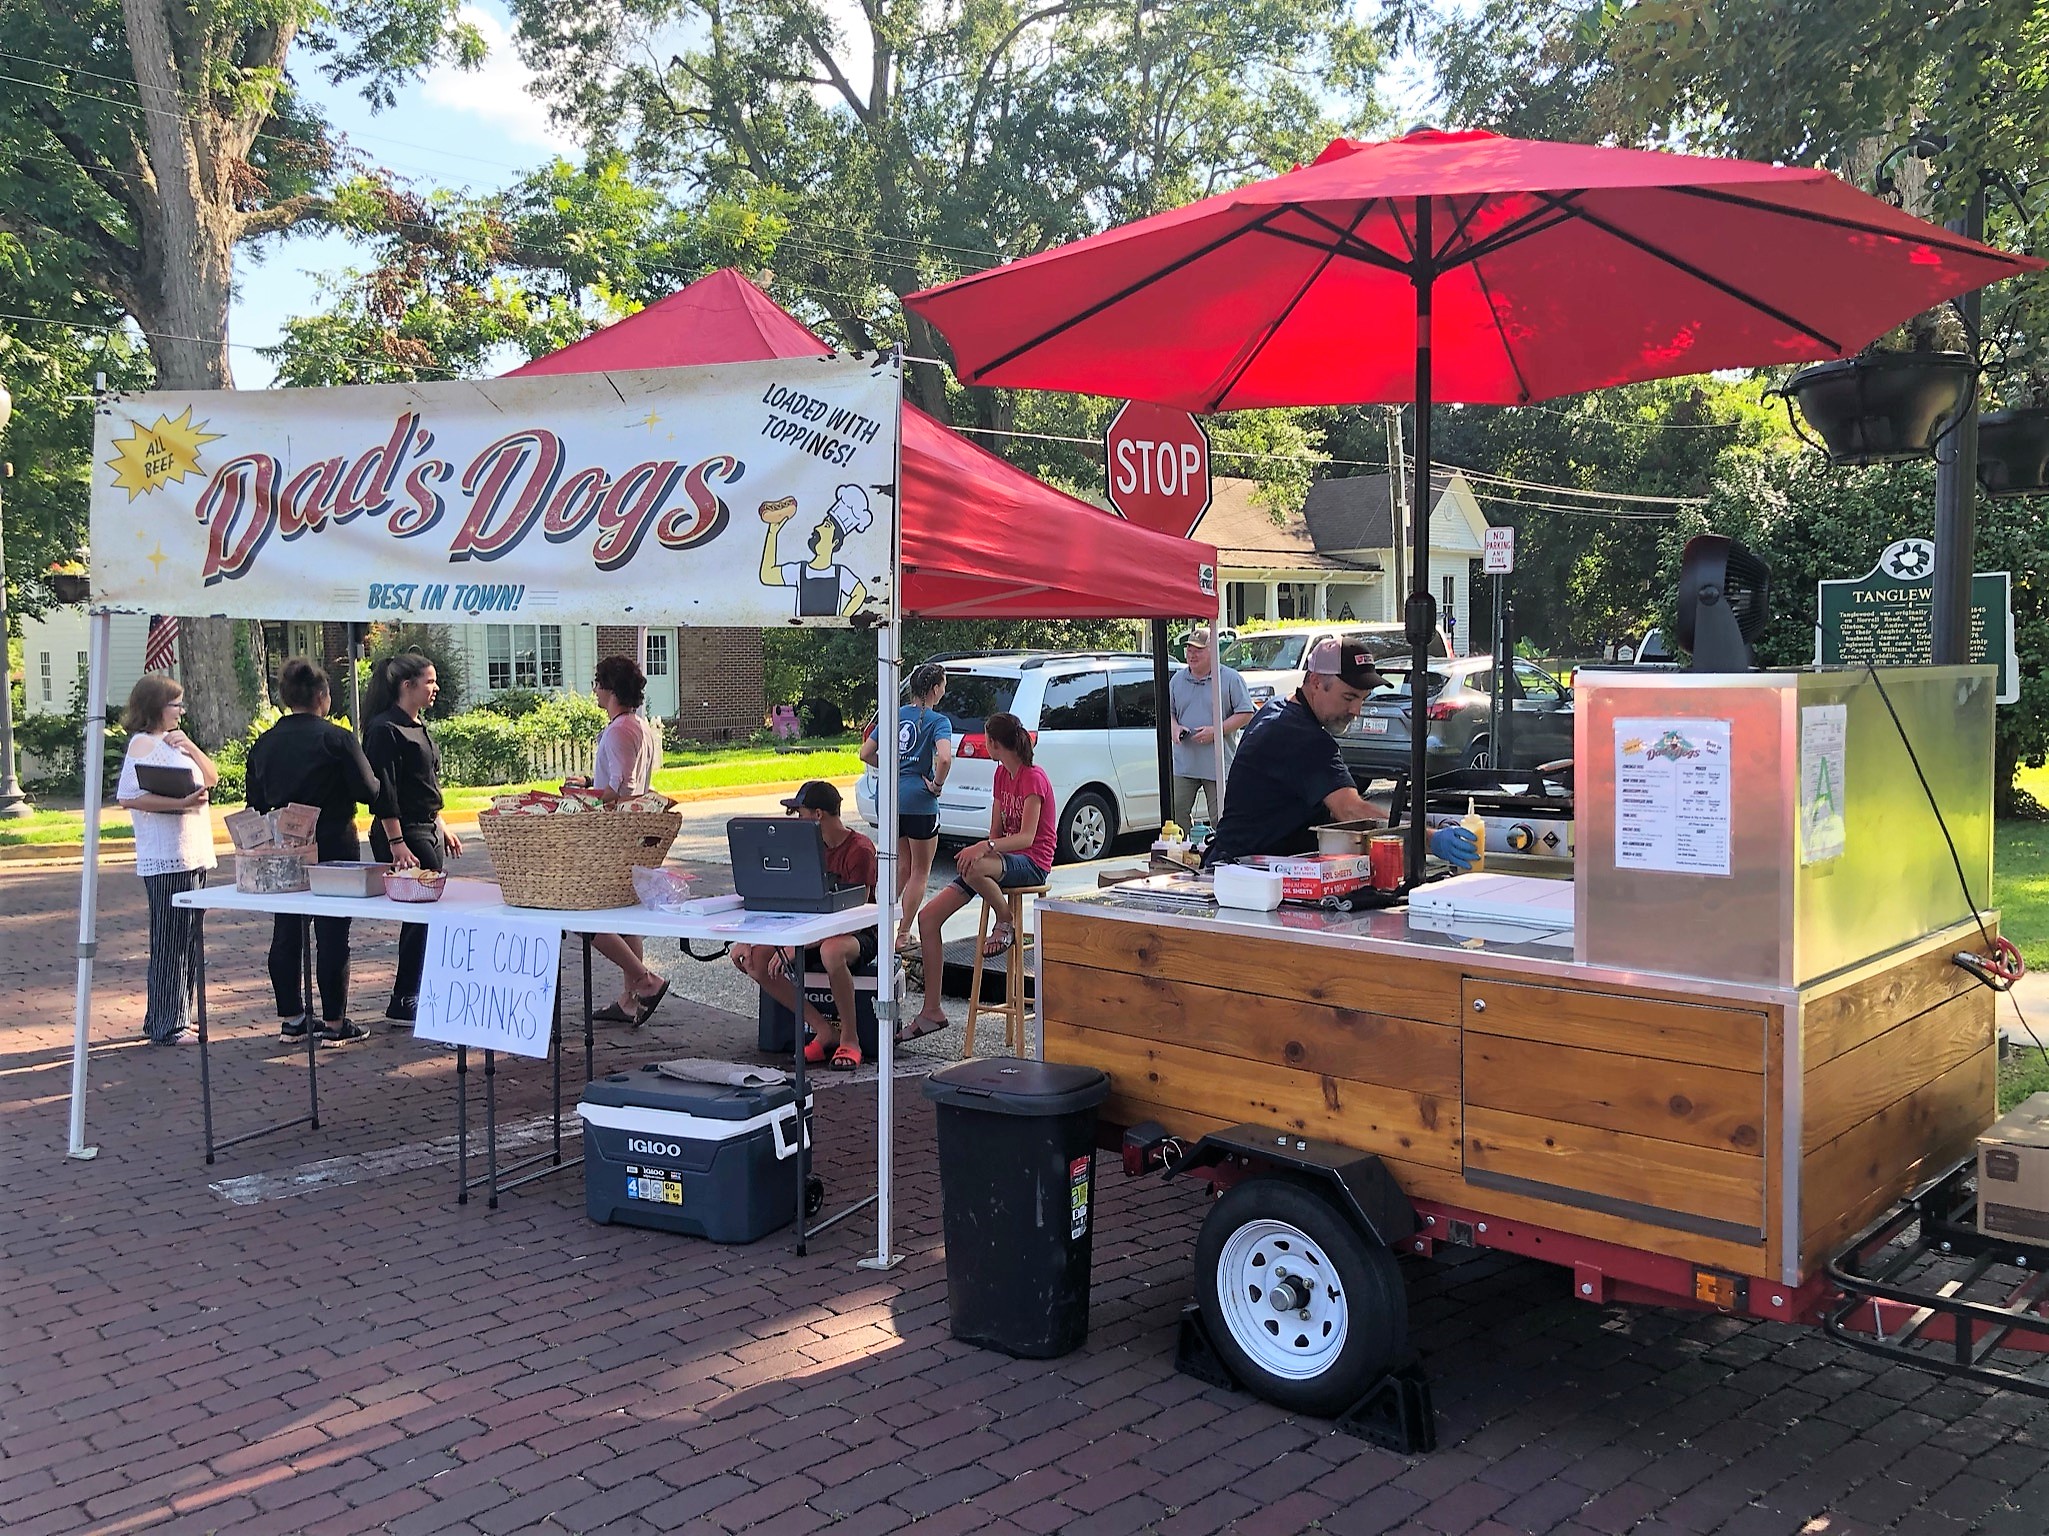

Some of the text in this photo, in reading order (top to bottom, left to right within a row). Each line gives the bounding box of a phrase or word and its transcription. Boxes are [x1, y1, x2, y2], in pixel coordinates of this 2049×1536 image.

[762, 382, 881, 445] LOADED WITH
[145, 436, 167, 458] ALL
[761, 414, 857, 468] TOPPINGS!
[144, 453, 174, 479] BEEF
[1116, 438, 1201, 497] STOP
[195, 411, 746, 587] Dad's Dogs
[1486, 541, 1512, 550] PARKING
[1493, 531, 1505, 540] NO
[368, 583, 525, 611] BEST IN TOWN!
[1852, 588, 1933, 603] TANGLEW
[1839, 611, 1875, 619] Tanglewood
[1895, 609, 1928, 617] originally
[441, 925, 550, 978] ICE COLD
[804, 992, 834, 1003] IGLO
[446, 980, 537, 1040] DRINKS
[628, 1137, 681, 1157] IGLOO
[628, 1179, 638, 1192] 4
